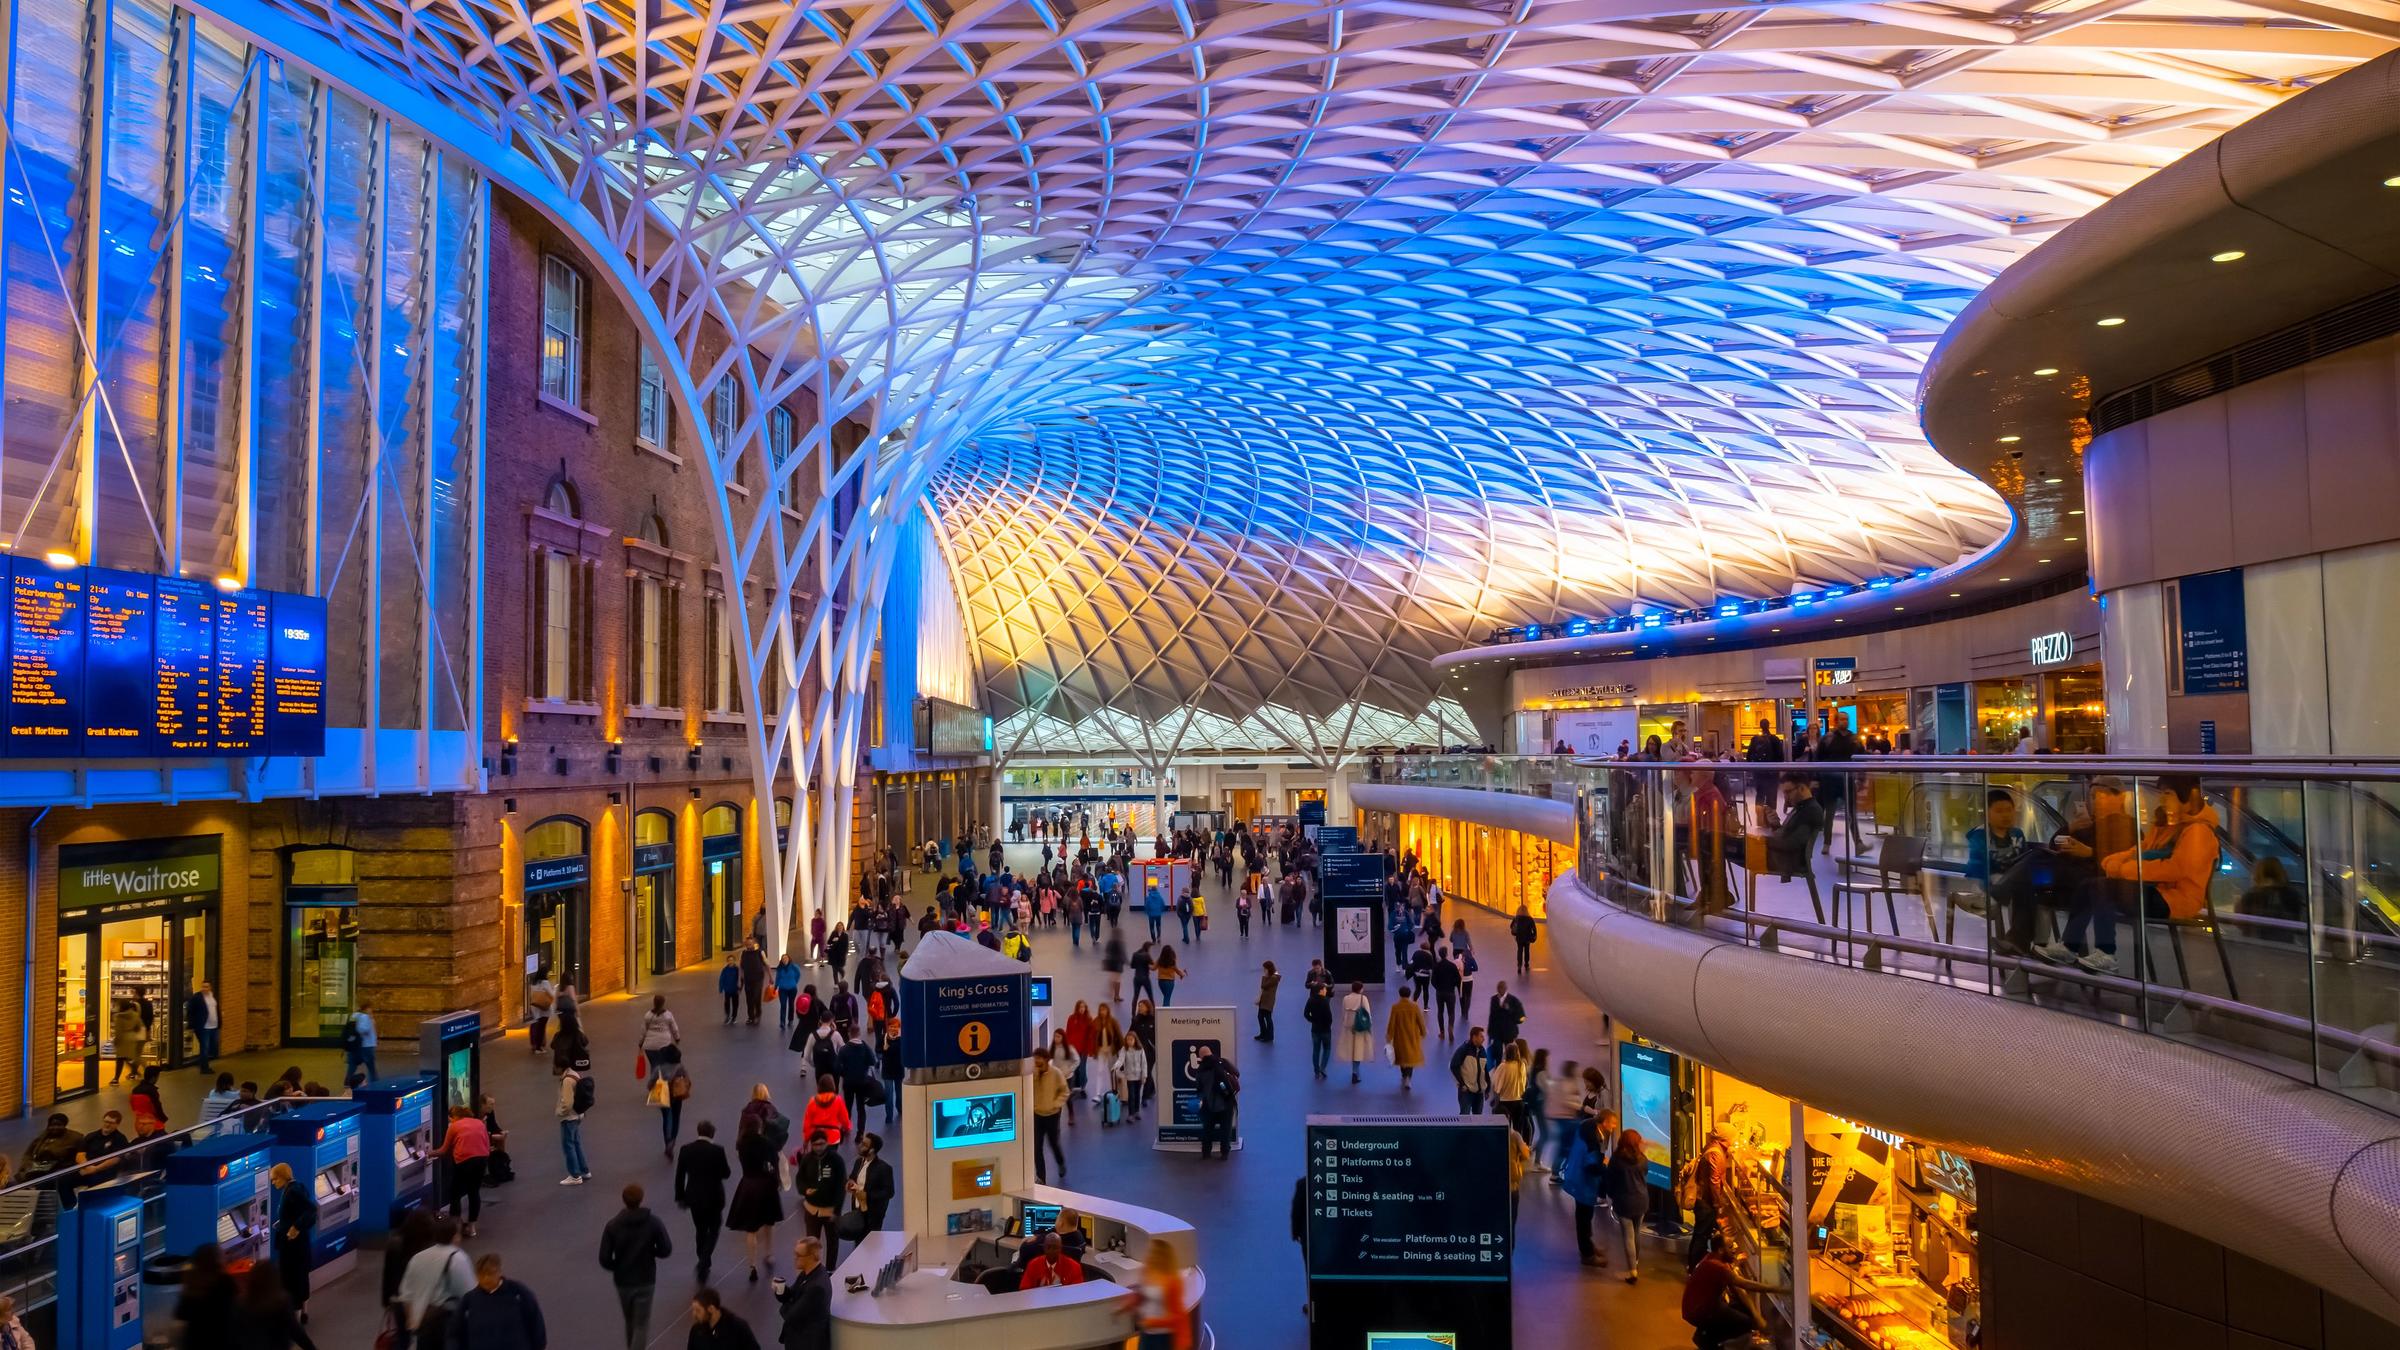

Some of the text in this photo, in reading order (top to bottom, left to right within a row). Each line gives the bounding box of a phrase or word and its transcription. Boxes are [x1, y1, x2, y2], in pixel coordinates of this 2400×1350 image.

[15, 576, 80, 591] 21:34 On time
[15, 587, 65, 600] Peterborough
[90, 585, 108, 594] 21:44
[90, 595, 99, 604] Ely
[2032, 632, 2068, 665] PREZZO
[11, 726, 69, 736] Great Northern
[87, 727, 138, 736] Great Northern
[543, 868, 562, 878] Platforms
[83, 866, 200, 895] little Waitrose
[938, 983, 1009, 999] King's Cross
[939, 1001, 1009, 1012] CUSTOMER INFORMATION
[1171, 1018, 1200, 1026] Meeting
[1341, 1140, 1399, 1151] Underground
[1341, 1157, 1412, 1167] Platforms 0 to 8
[1812, 1157, 1825, 1167] THE
[1341, 1174, 1363, 1184] Taxis
[1341, 1192, 1371, 1202] Dining
[1372, 1191, 1380, 1200] &
[1381, 1191, 1414, 1202] seating
[1342, 1208, 1373, 1217] Tickets
[1405, 1234, 1448, 1243] Platforms
[1450, 1234, 1456, 1243] 0
[1458, 1235, 1469, 1243] to
[1470, 1234, 1476, 1243] 8
[1403, 1251, 1432, 1261] Dining
[1434, 1251, 1442, 1260] &
[1443, 1251, 1476, 1262] seating
